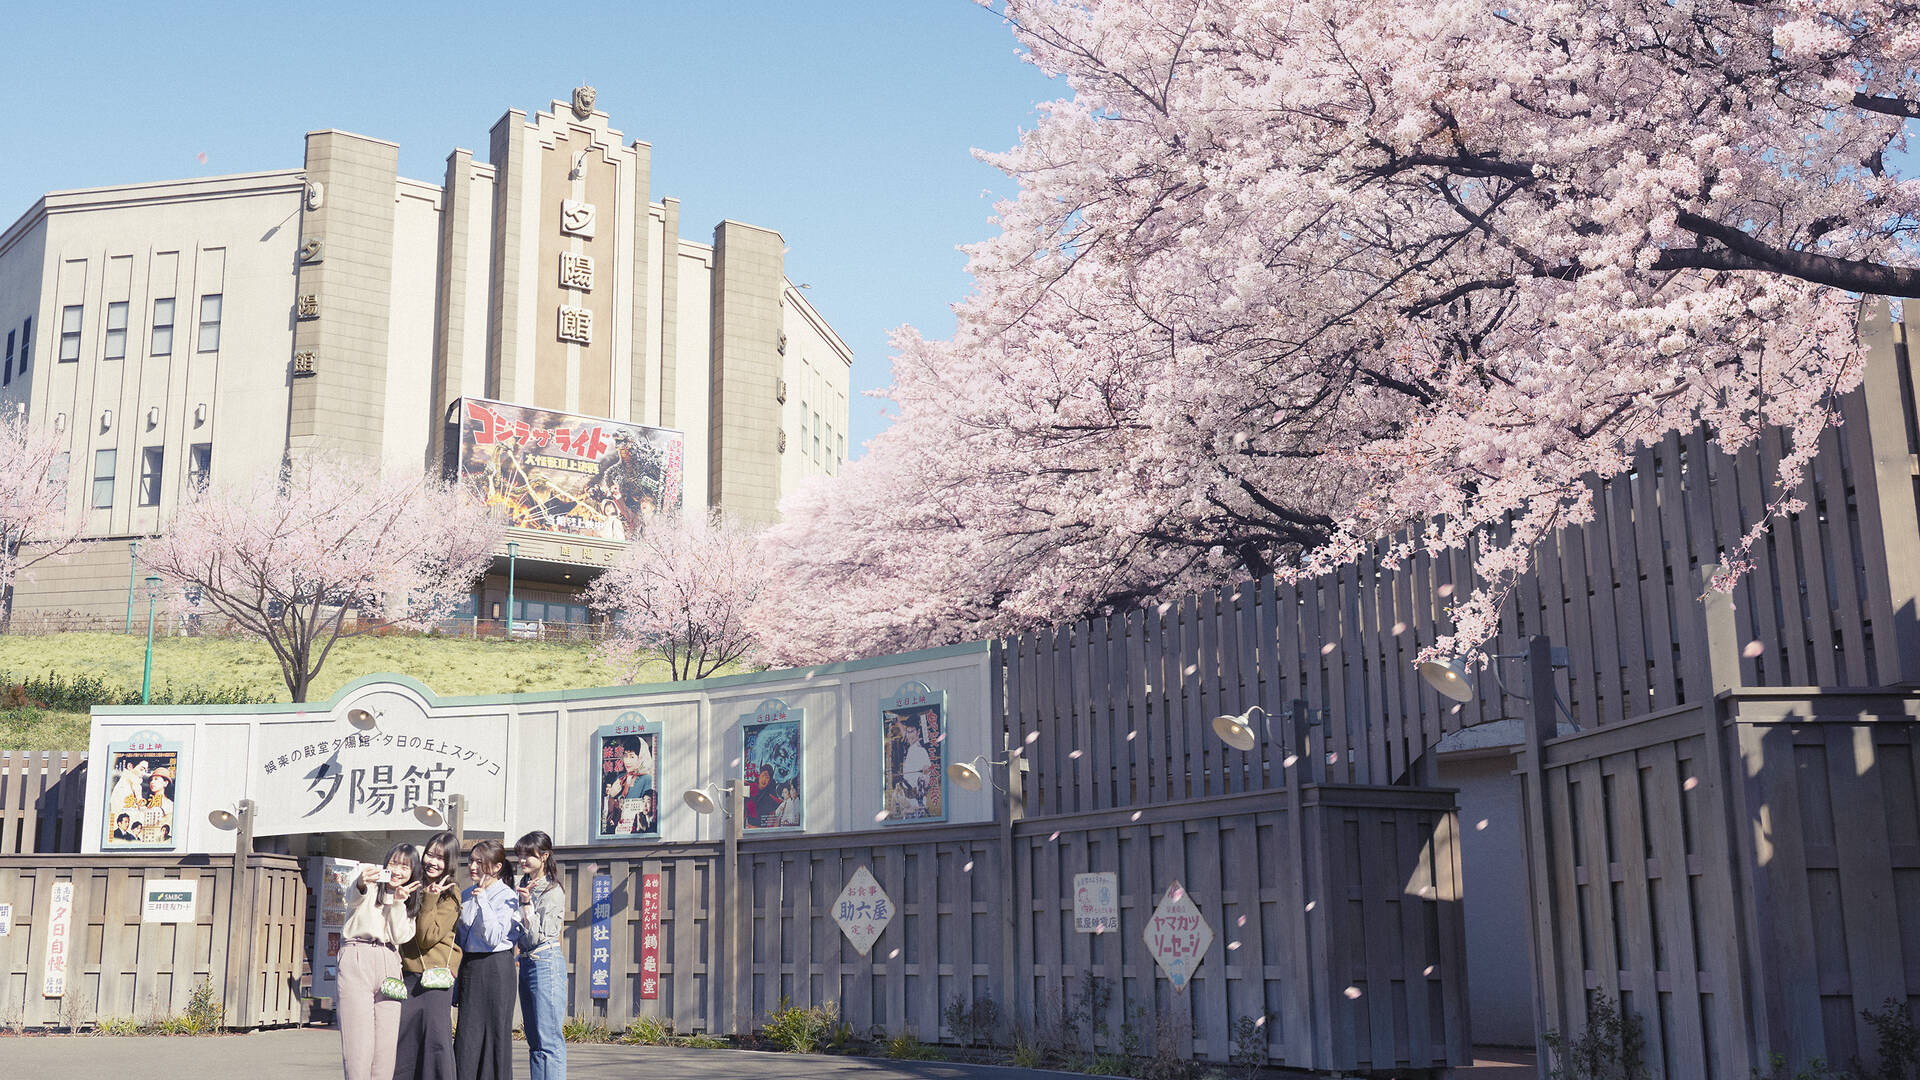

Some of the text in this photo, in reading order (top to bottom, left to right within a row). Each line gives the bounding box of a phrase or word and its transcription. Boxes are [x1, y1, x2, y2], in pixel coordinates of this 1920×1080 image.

[562, 203, 594, 341] 夕陽館
[896, 696, 926, 707] 近日上映
[757, 712, 787, 723] 近日上映
[615, 725, 645, 735] 近日上映
[129, 743, 163, 751] 近日上映
[301, 762, 455, 818] 夕陽館
[164, 893, 184, 901] SMBC
[848, 885, 877, 897] お食事
[839, 898, 888, 921] 助六屋
[851, 924, 874, 935] 定食
[1154, 915, 1200, 932] ヤマカツ
[47, 906, 67, 972] 夕日自慢
[592, 903, 611, 986] 棚牡丹堂
[1154, 932, 1200, 957] ソーセージ
[643, 933, 658, 994] 鶴亀堂
